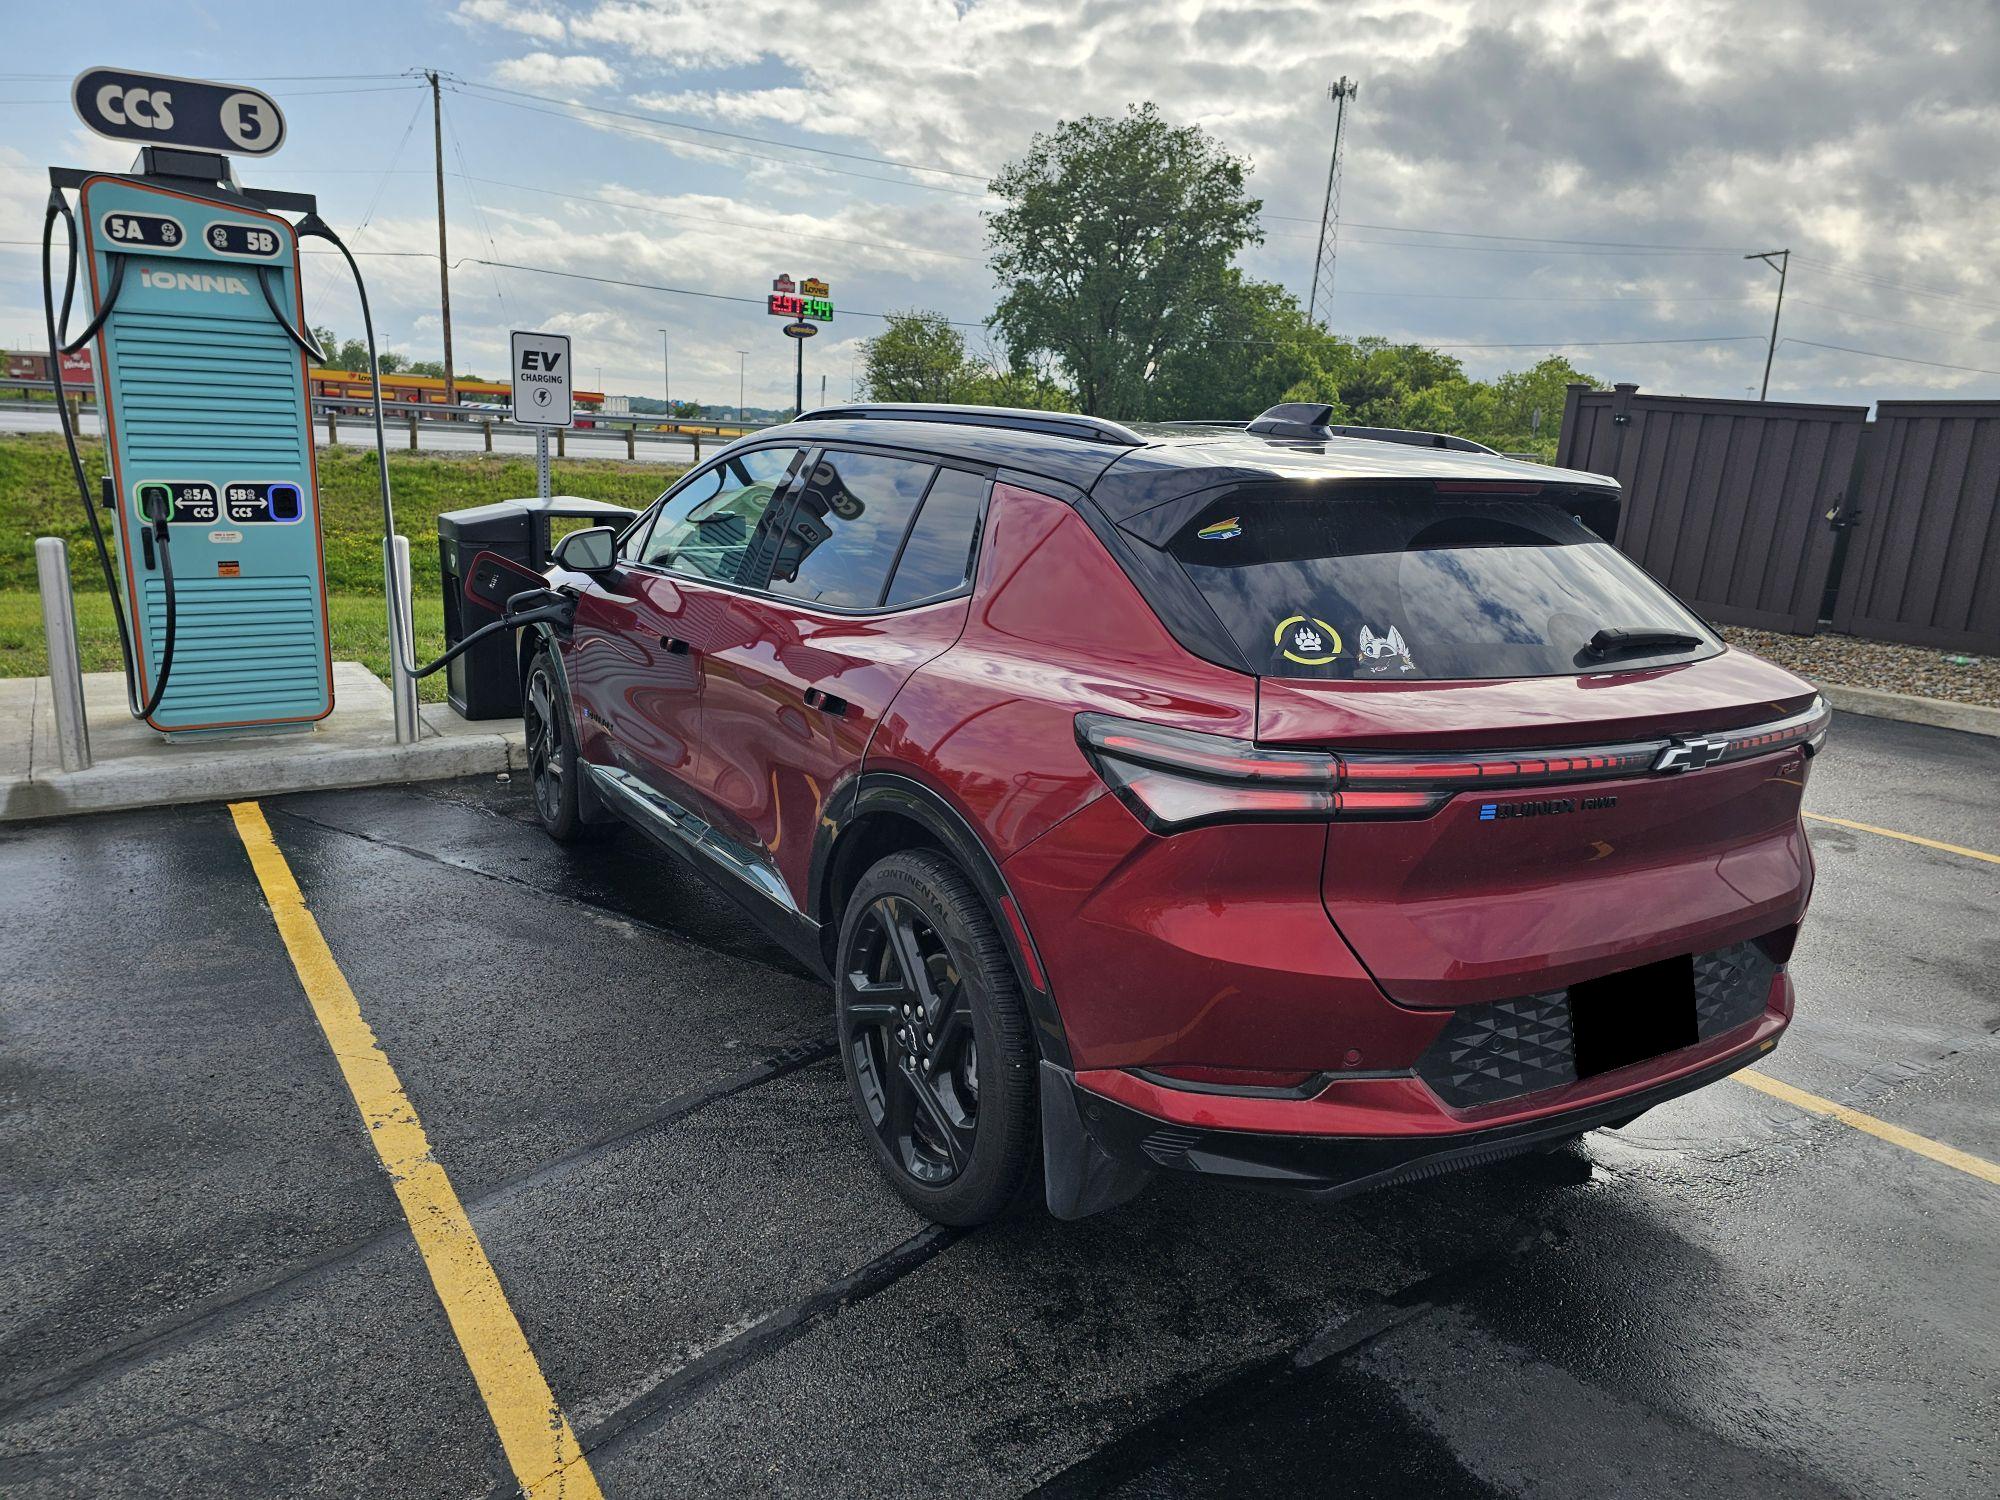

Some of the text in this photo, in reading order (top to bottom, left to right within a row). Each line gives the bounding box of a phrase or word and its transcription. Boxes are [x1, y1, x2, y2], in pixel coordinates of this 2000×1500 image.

[96, 84, 262, 140] CCS 5
[111, 218, 144, 241] 5A
[246, 232, 273, 252] 5B
[521, 350, 561, 372] EV
[521, 373, 562, 384] CHARGING
[192, 488, 213, 501] 5A
[229, 488, 247, 501] 5B
[193, 507, 215, 518] CCS
[231, 507, 253, 518] CCS
[876, 869, 950, 921] CONTINENTAL
